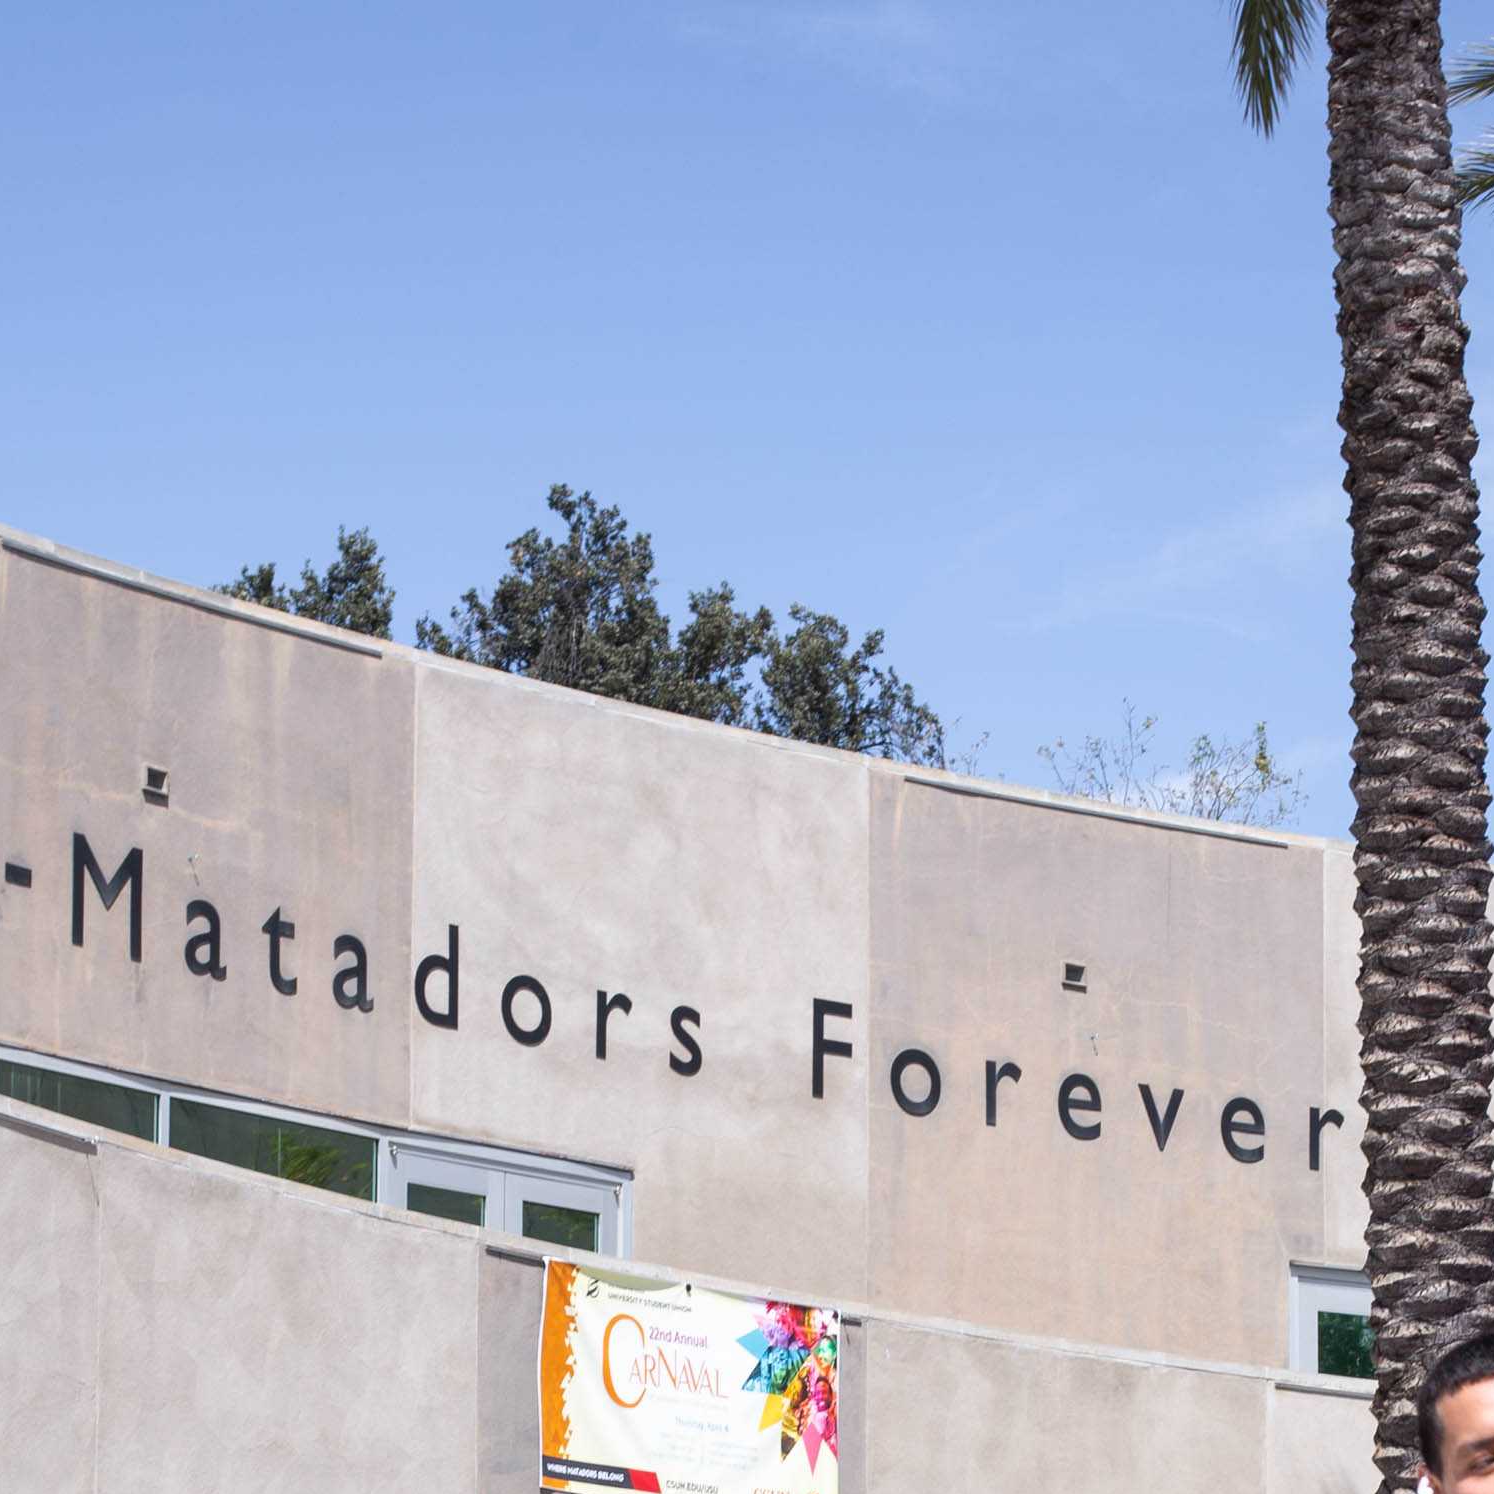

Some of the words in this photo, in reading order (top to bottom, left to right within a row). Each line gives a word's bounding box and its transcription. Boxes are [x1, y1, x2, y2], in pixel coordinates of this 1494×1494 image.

[811, 997, 1345, 1172] Forever
[648, 1326, 672, 1342] 22nd
[674, 1331, 708, 1348] Annual
